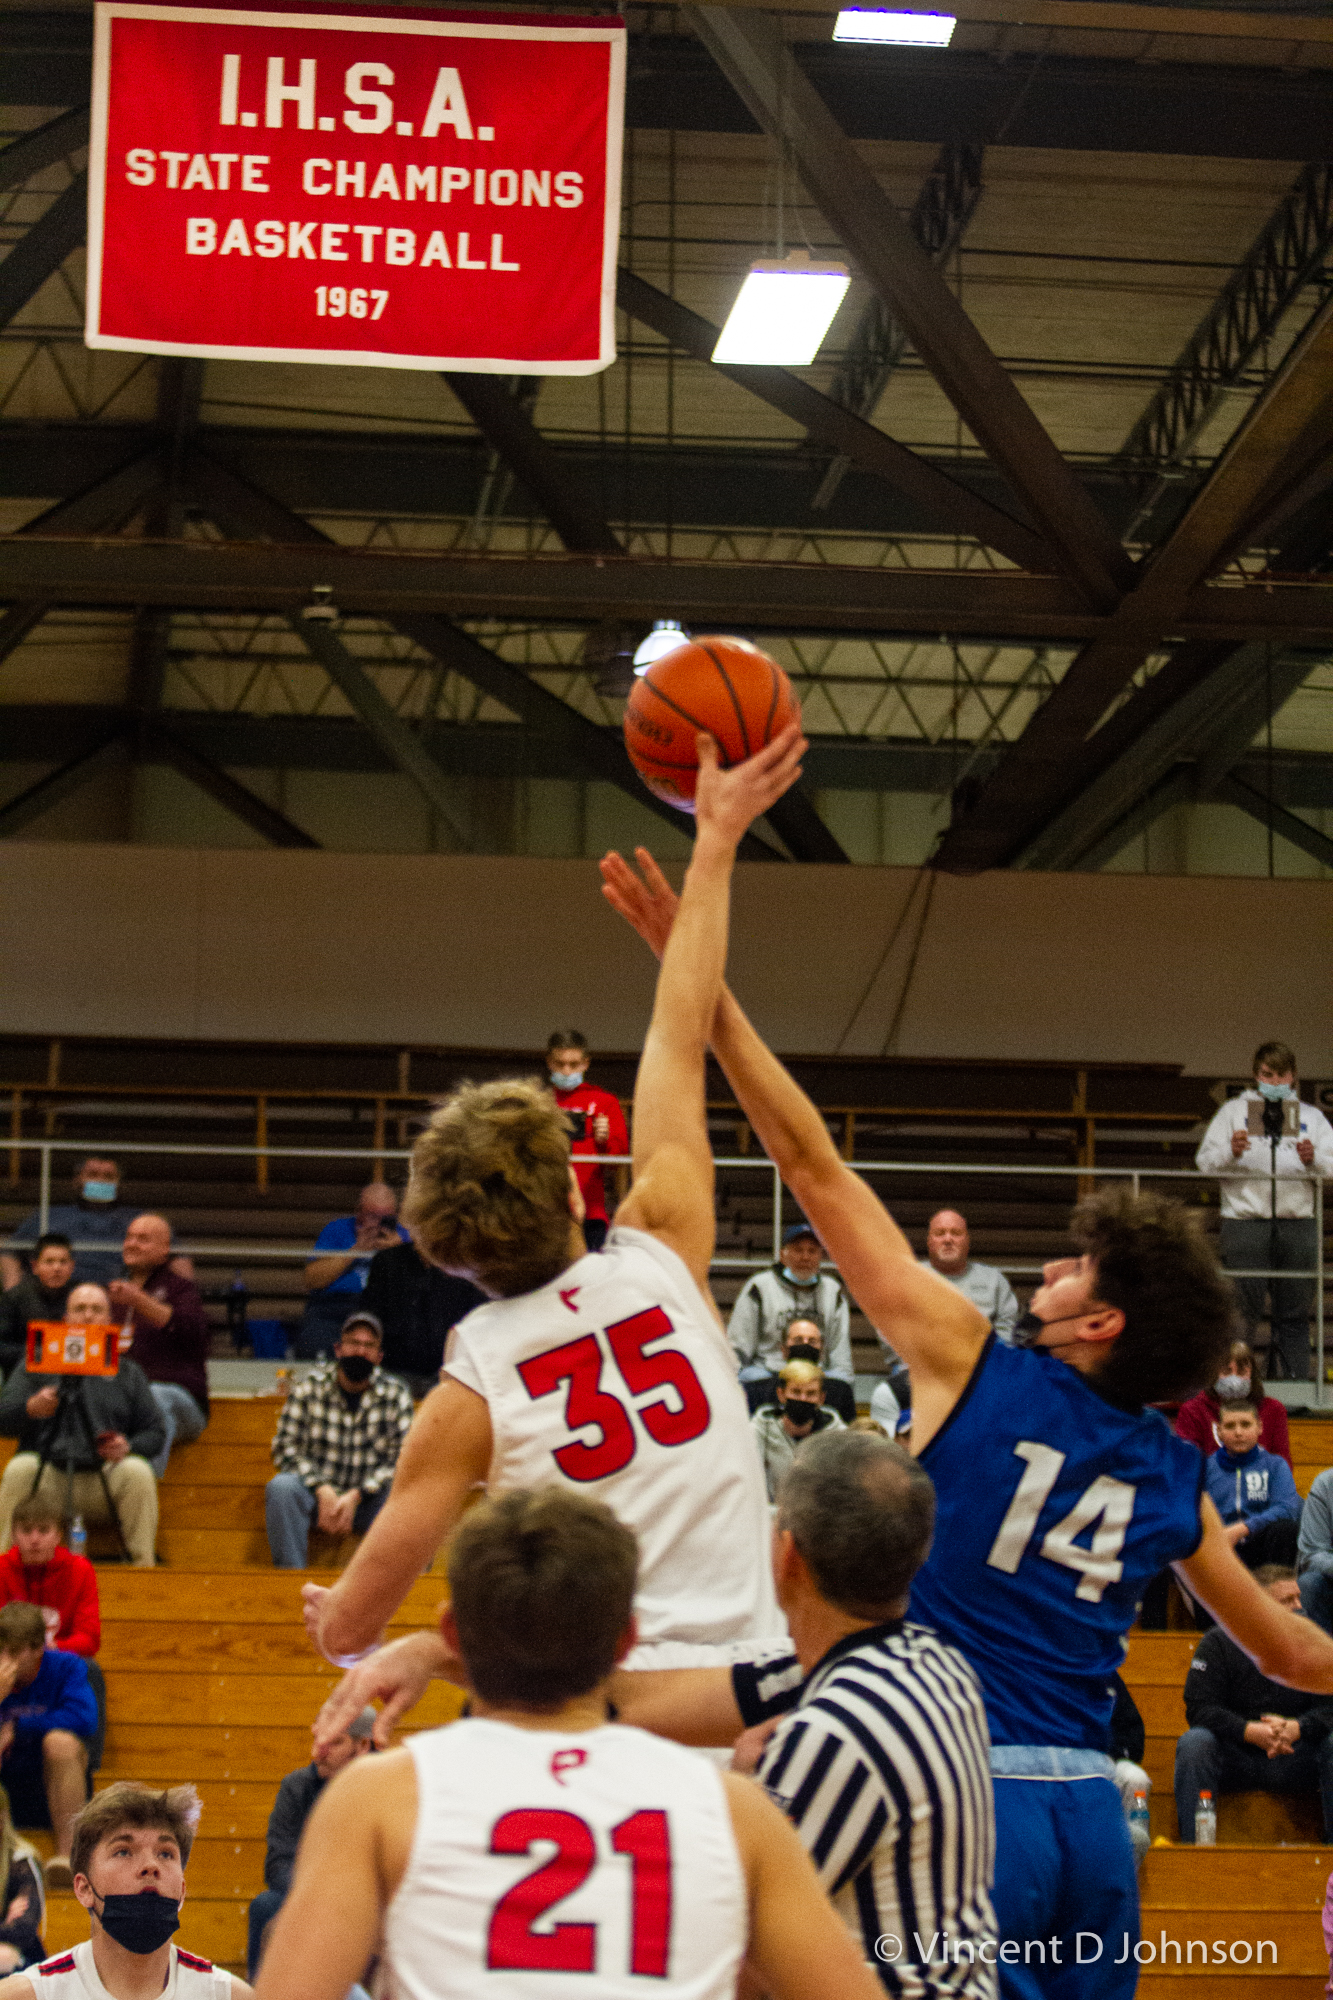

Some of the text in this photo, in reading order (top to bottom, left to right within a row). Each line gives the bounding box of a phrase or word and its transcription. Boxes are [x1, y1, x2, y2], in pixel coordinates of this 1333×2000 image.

[220, 54, 495, 141] I.H.S.A.
[126, 149, 584, 209] STATE CHAMPIONS
[187, 217, 520, 272] BASKETBALL
[315, 285, 389, 321] 1967
[515, 1305, 711, 1482] 35
[986, 1440, 1137, 1603] 14
[486, 1808, 671, 1979] 21
